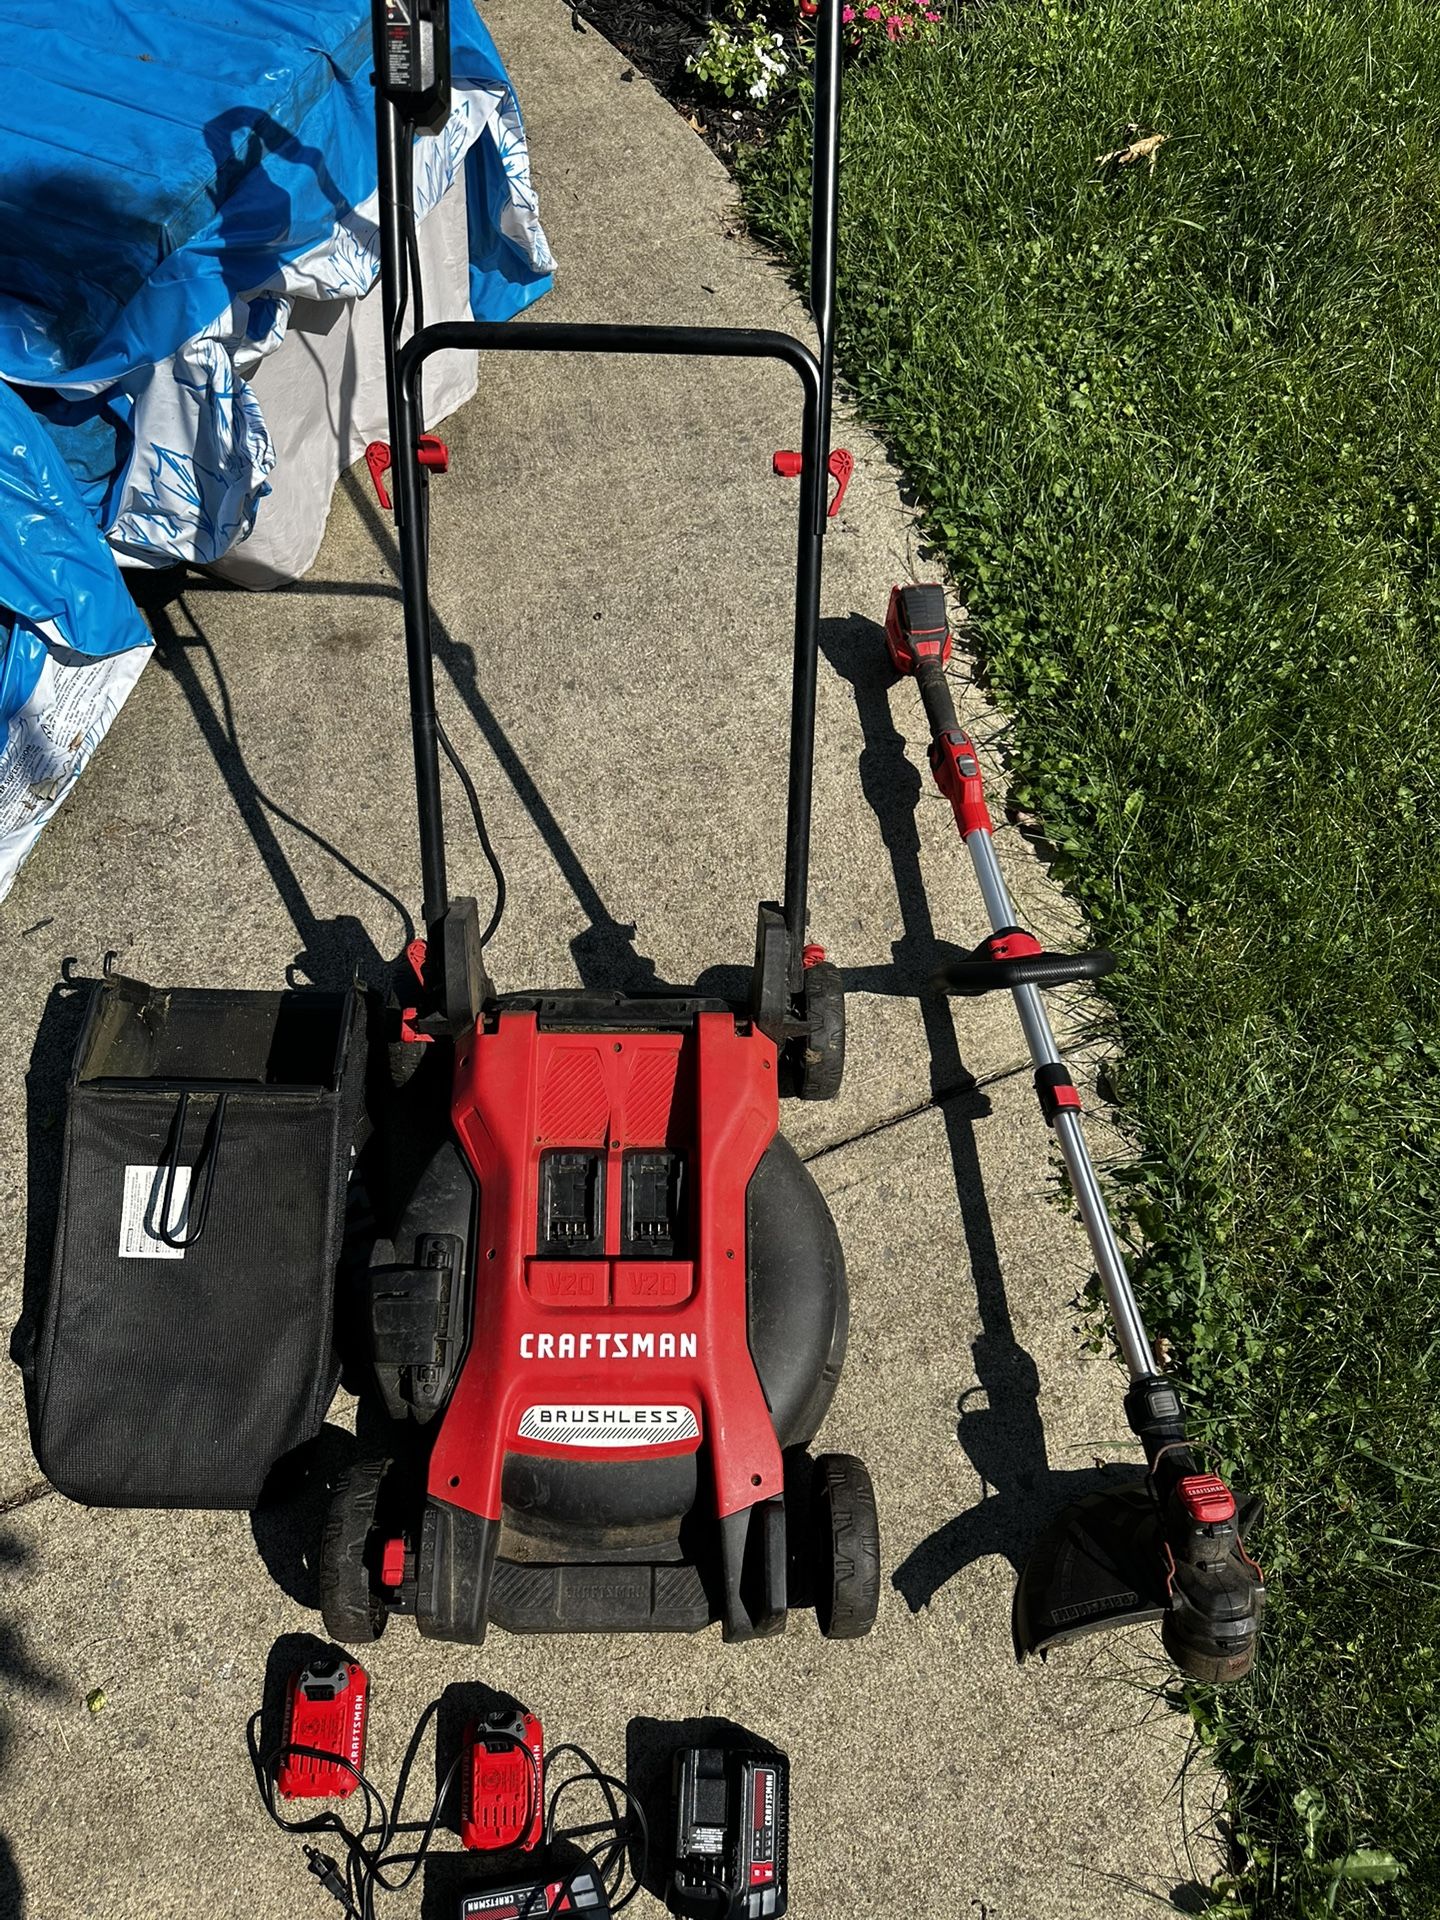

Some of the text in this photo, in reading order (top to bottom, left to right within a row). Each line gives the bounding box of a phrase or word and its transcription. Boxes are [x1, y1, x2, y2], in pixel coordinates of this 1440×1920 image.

[546, 1271, 596, 1297] V20
[629, 1271, 678, 1296] V20
[520, 1333, 697, 1359] CRAFTSMAN
[540, 1410, 678, 1423] BRUSHLESS
[1188, 1486, 1225, 1496] CRAFTSMAN
[350, 1694, 363, 1765] CRAFTSMAN
[765, 1774, 774, 1826] CRAFTSMAN
[467, 1894, 515, 1912] CRAFTSMAN
